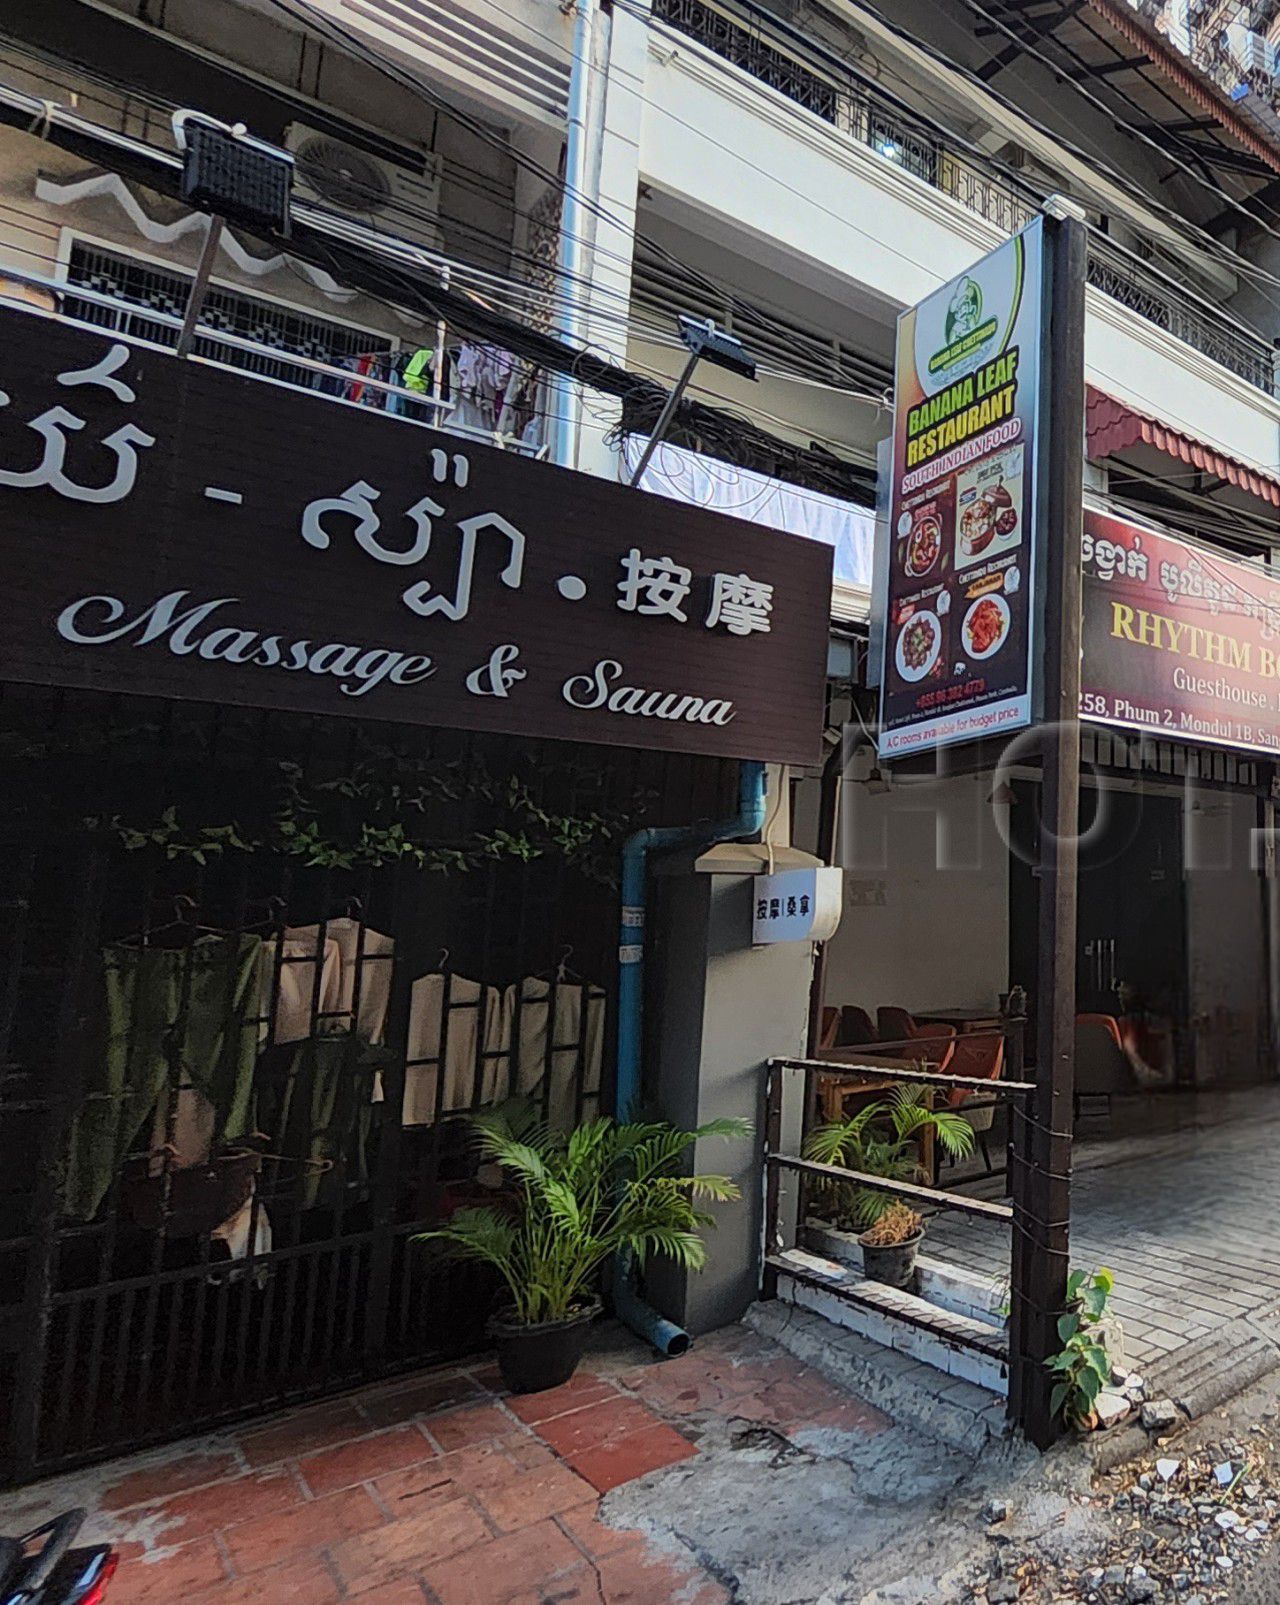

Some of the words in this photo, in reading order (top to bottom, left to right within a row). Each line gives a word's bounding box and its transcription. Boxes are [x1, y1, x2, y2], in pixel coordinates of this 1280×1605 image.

[907, 385, 1016, 467] RESTAURANT
[908, 378, 972, 437] BANANA
[976, 352, 1017, 401] LEAF
[902, 457, 944, 493] SOUTH
[945, 440, 985, 474] INDIAN
[985, 421, 1021, 451] FOOD
[617, 547, 775, 636] 按摩
[57, 590, 437, 696] Massage
[466, 644, 527, 698] &
[562, 658, 737, 728] Sauna
[1110, 602, 1252, 672] RHYTHM
[1114, 699, 1160, 725] Phum
[1163, 709, 1177, 729] 2,
[1181, 712, 1232, 738] Mondul
[1236, 725, 1255, 745] 1B,
[1173, 667, 1267, 708] Guesthouse
[900, 730, 922, 746] rooms
[969, 711, 997, 732] budget
[998, 706, 1019, 726] price
